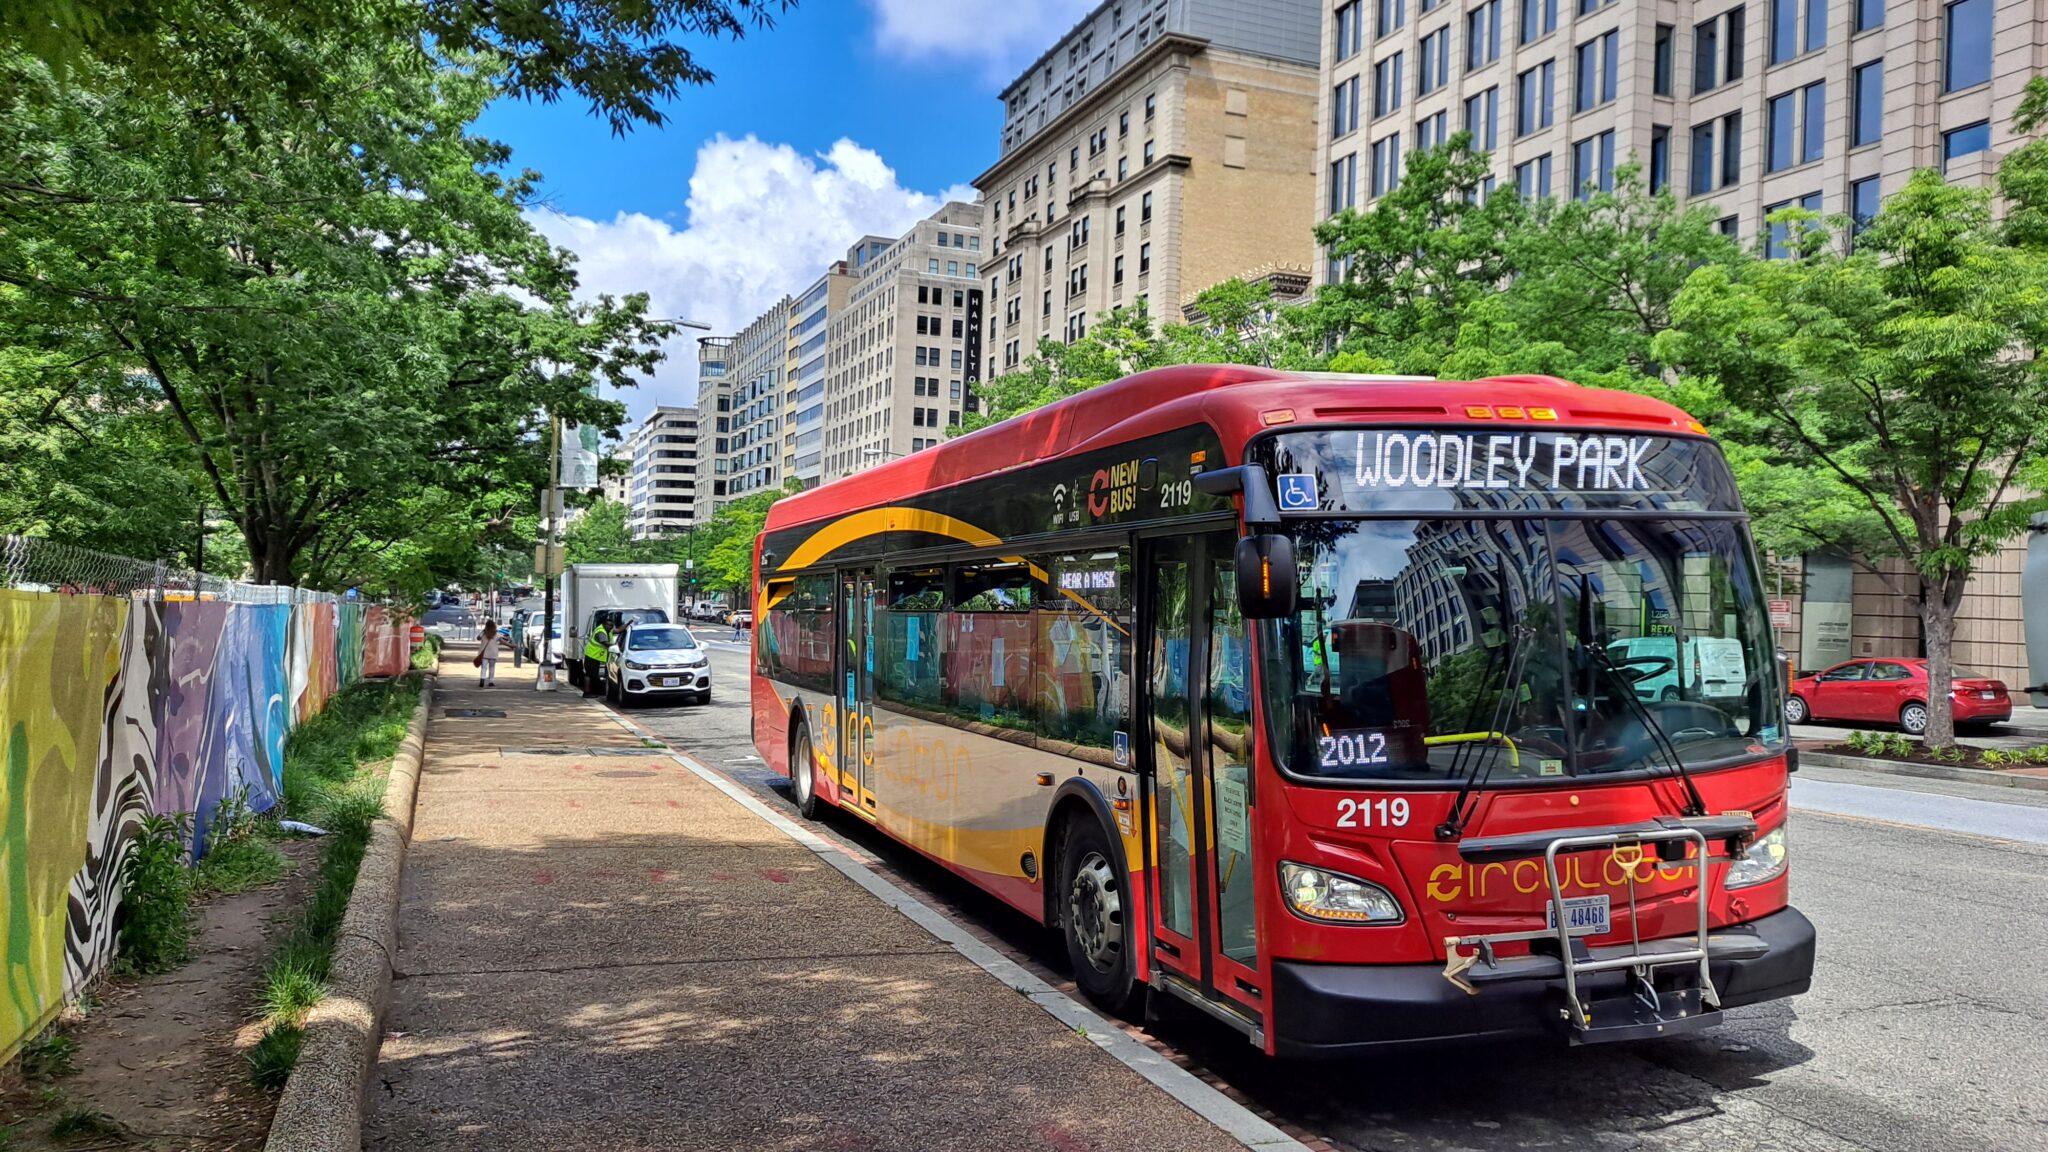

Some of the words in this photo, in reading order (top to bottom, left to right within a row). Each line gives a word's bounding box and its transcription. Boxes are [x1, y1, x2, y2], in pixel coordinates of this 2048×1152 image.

[968, 297, 979, 397] HAMILTON
[1111, 459, 1139, 488] NEW
[1355, 433, 1536, 488] WOODLEY
[1552, 437, 1653, 489] PARK
[1110, 485, 1137, 513] BUS!
[1160, 480, 1191, 508] 2119
[1053, 513, 1064, 525] WIFI
[1068, 510, 1080, 522] USB
[1062, 572, 1082, 588] WEAR
[1084, 572, 1090, 588] A
[1092, 571, 1116, 588] MASK
[1650, 624, 1677, 633] RETAI
[1320, 733, 1387, 766] 2012
[1336, 797, 1410, 828] 2119
[1571, 906, 1604, 926] 48468
